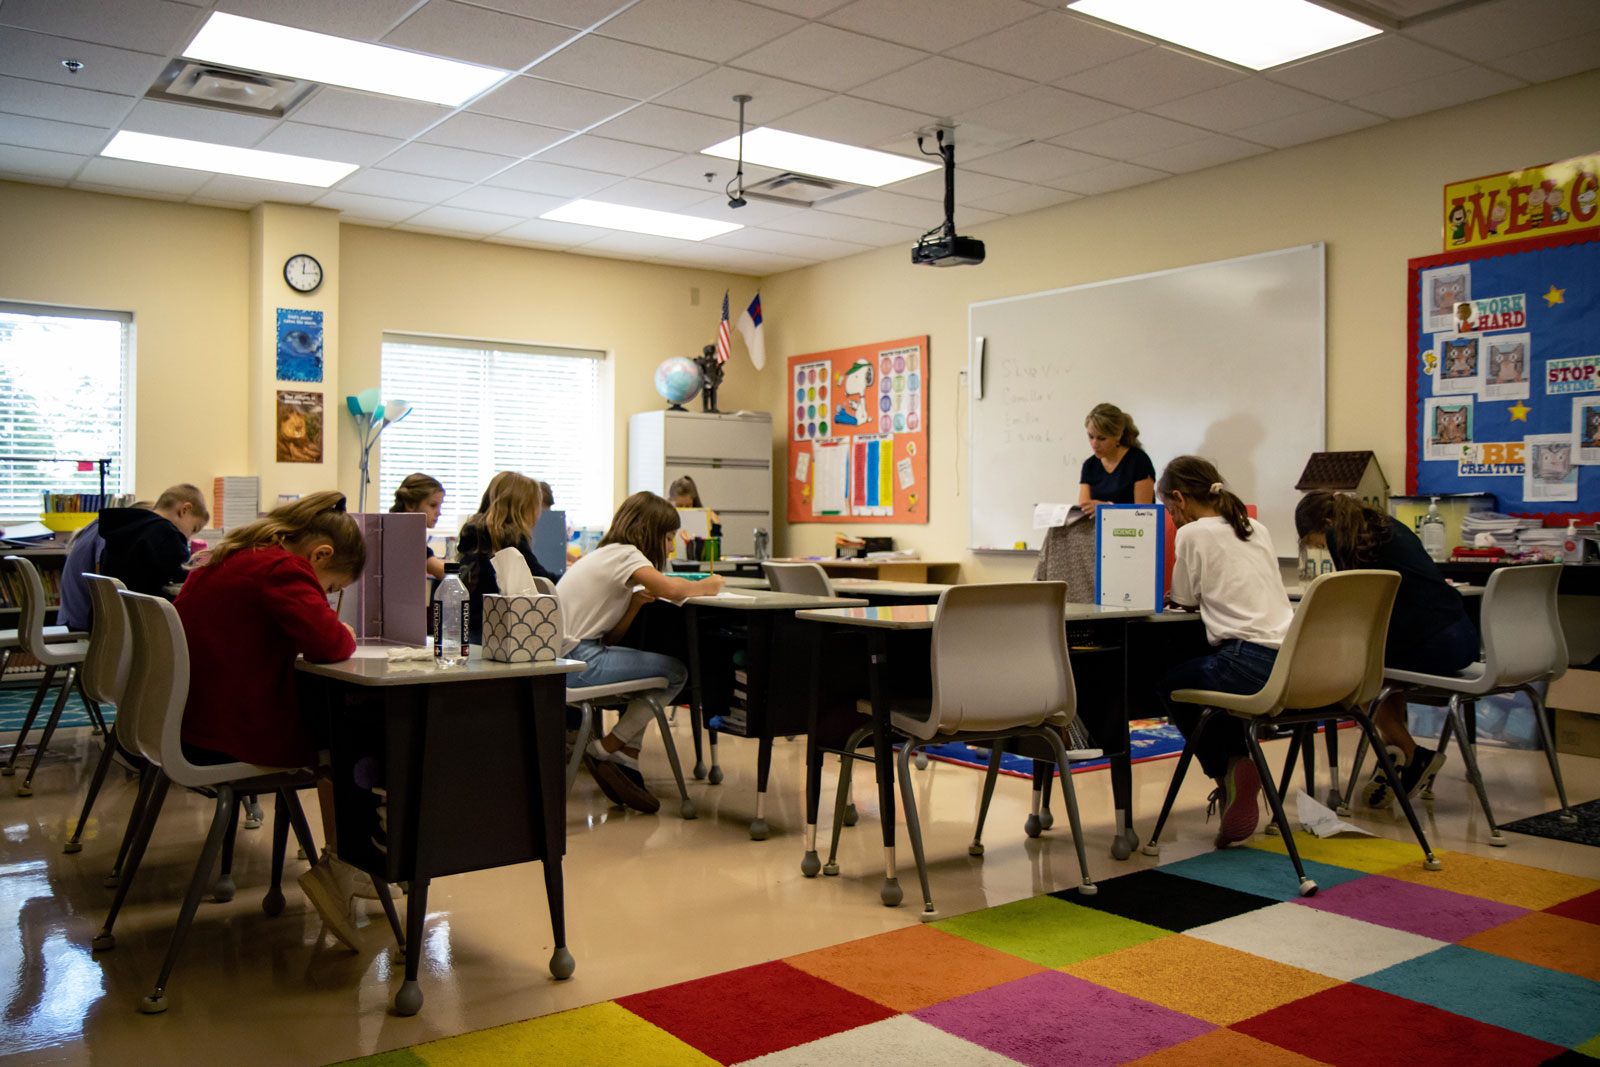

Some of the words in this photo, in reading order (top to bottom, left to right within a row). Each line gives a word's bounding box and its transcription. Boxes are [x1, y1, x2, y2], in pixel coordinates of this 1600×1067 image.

[1475, 295, 1524, 315] WORK
[1477, 311, 1525, 331] HARD
[1549, 365, 1595, 383] STOP
[1482, 443, 1525, 464] BE
[1460, 463, 1526, 474] CREATIVE
